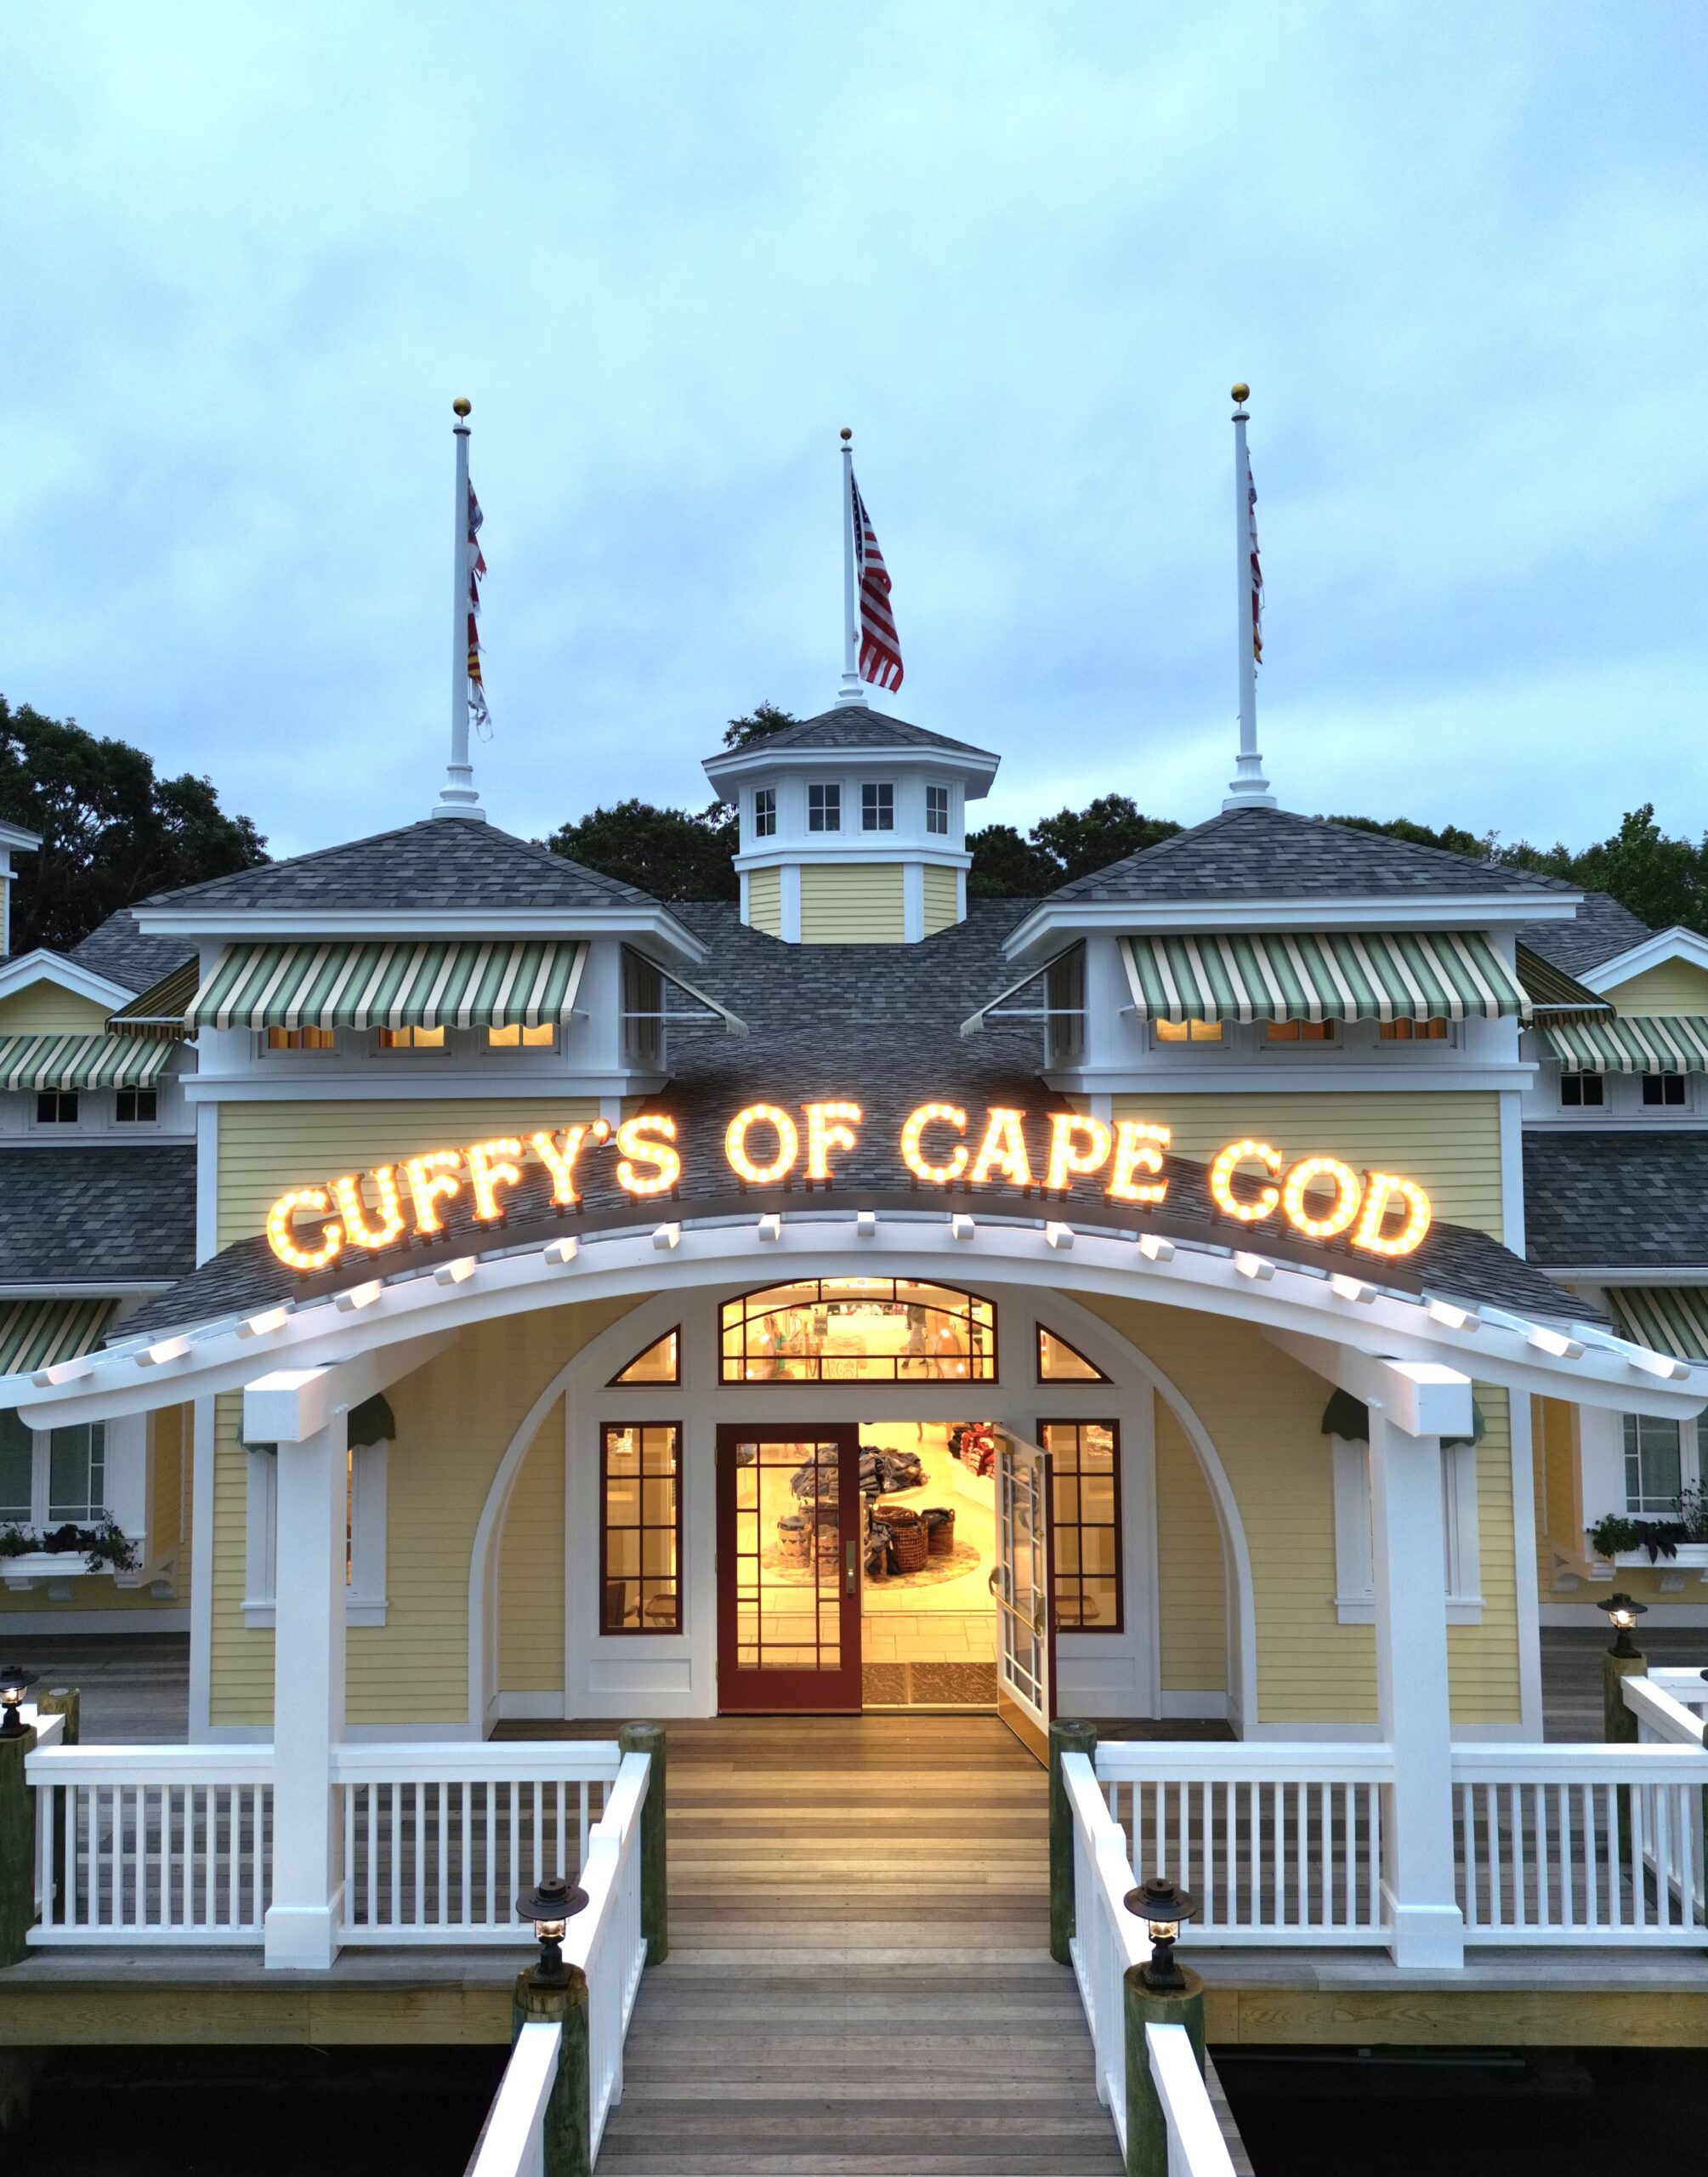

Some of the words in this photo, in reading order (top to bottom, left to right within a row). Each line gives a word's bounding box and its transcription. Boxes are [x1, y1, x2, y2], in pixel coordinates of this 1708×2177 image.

[266, 1113, 682, 1269] CUFFY'S
[724, 1102, 862, 1184] OF
[900, 1102, 1172, 1202] CAPE
[1210, 1139, 1432, 1256] COD
